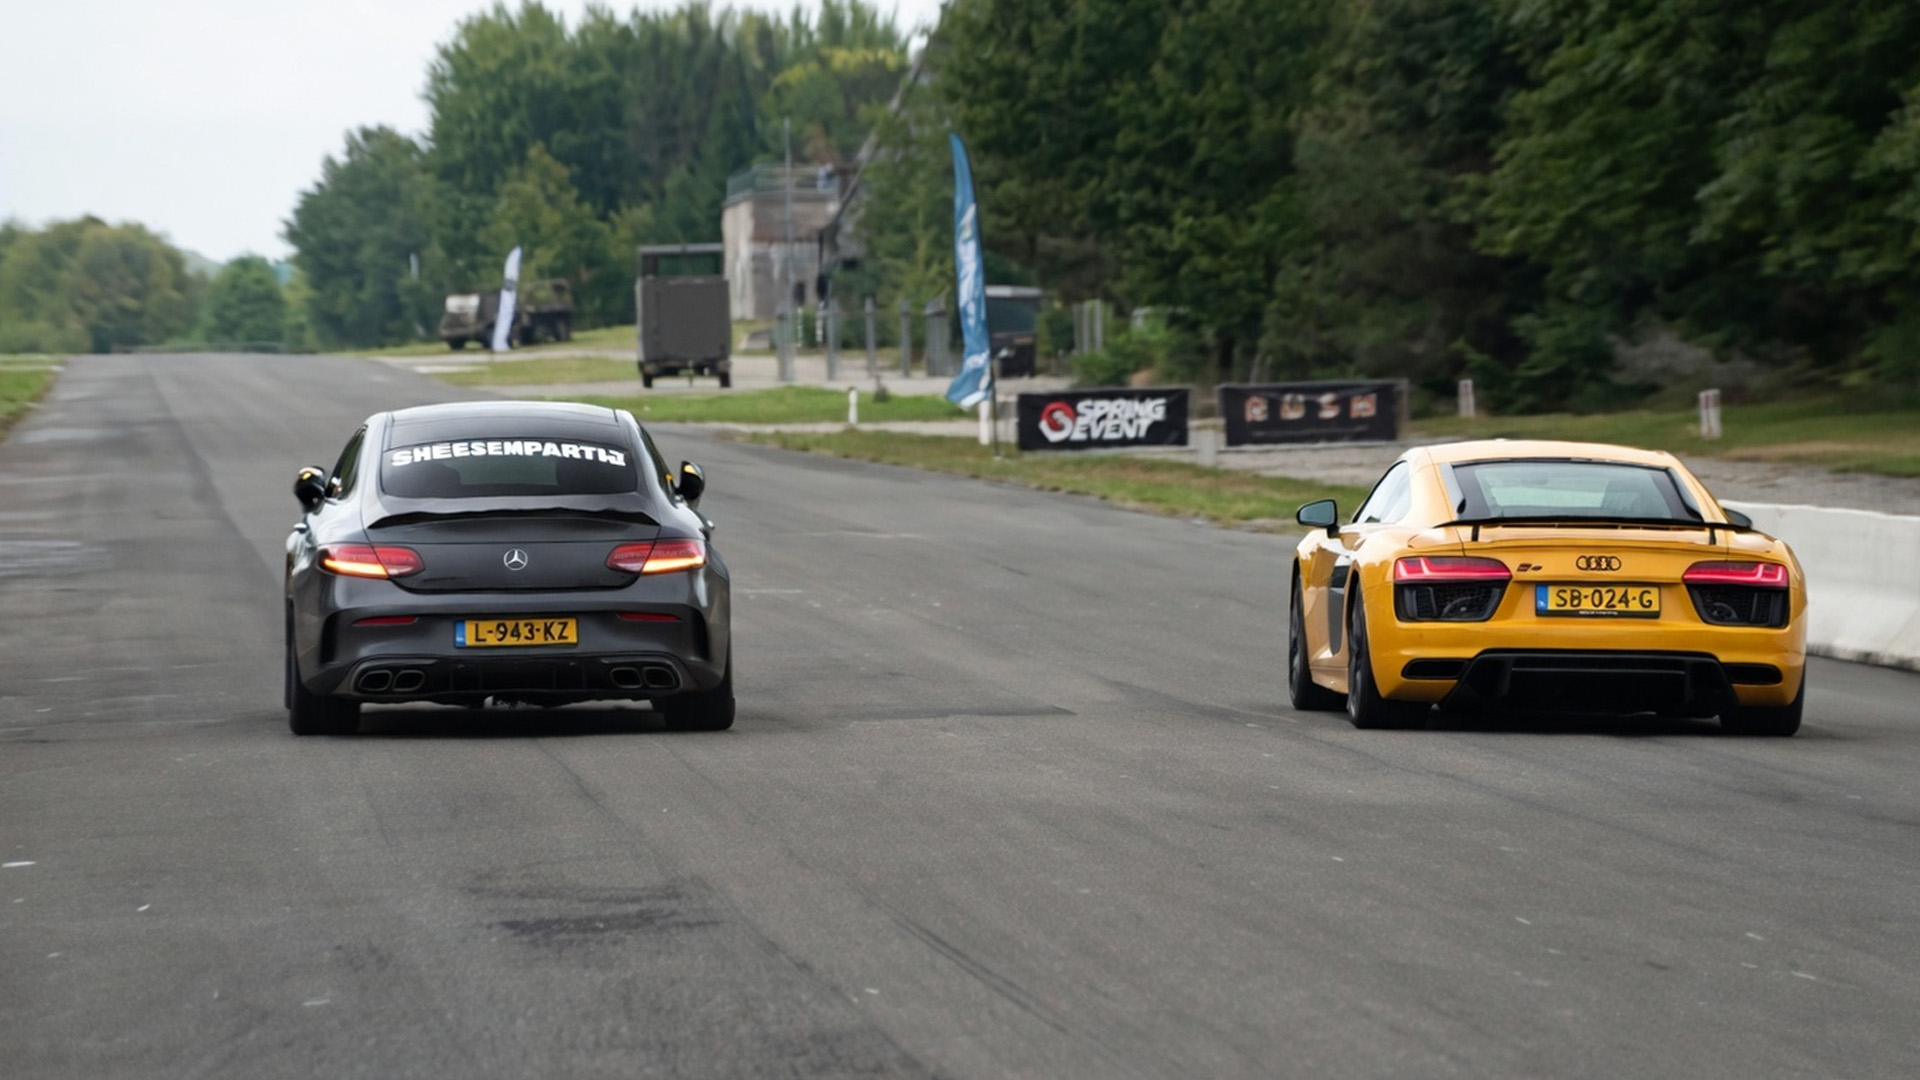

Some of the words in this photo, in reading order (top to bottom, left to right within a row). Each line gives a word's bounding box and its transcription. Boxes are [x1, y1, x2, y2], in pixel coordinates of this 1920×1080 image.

[1077, 398, 1167, 422] SPRING
[1071, 418, 1153, 440] EVENT
[1555, 589, 1653, 609] SB-024-G
[475, 621, 569, 642] L-943-KZ
